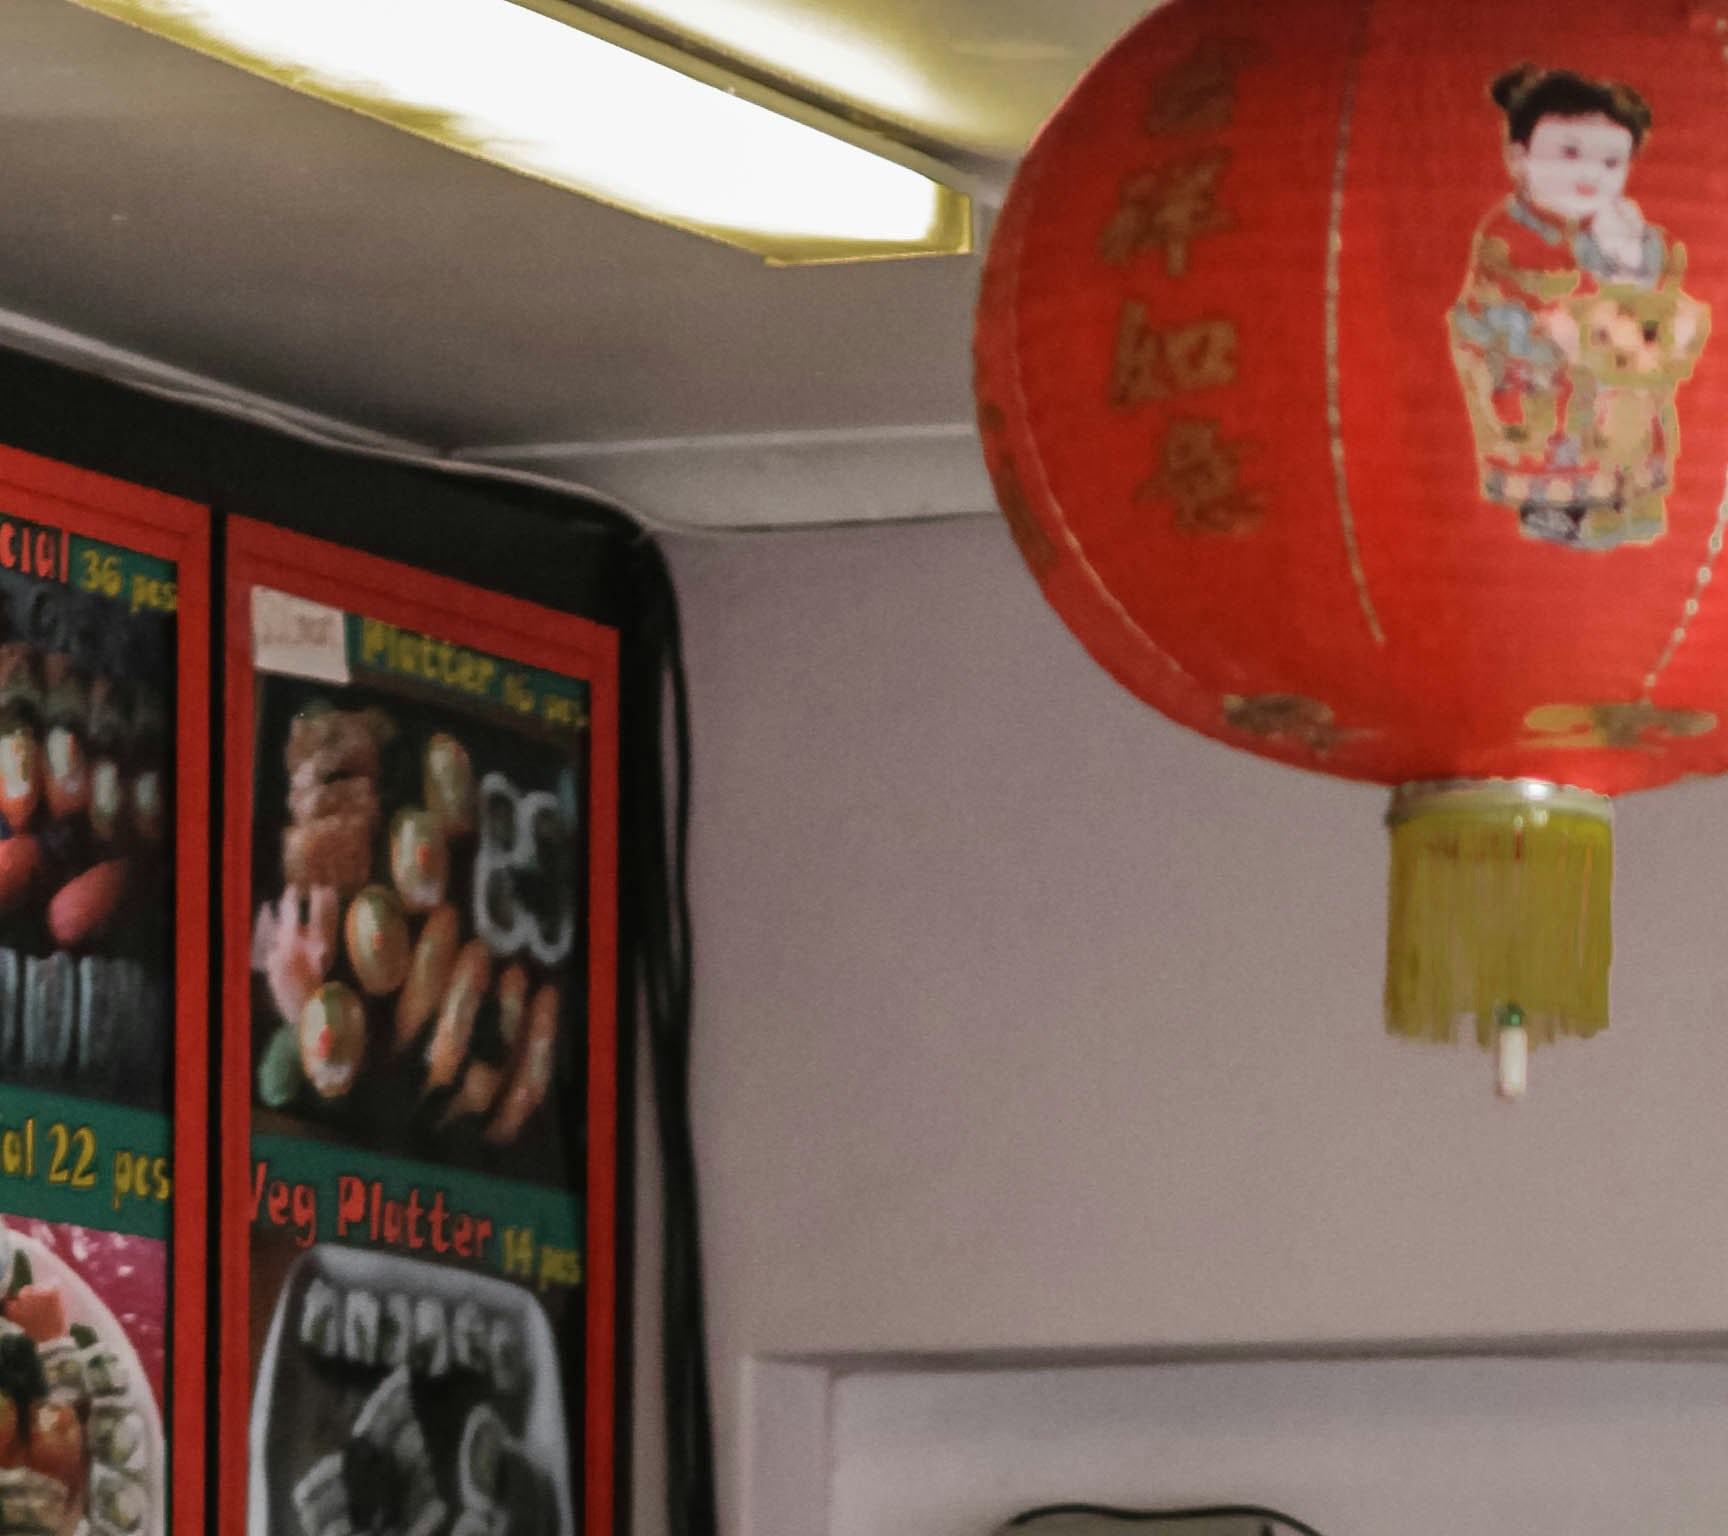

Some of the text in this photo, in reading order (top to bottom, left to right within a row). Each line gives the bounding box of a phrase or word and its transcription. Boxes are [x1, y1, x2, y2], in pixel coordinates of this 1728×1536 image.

[80, 549, 123, 598] 36
[49, 1122, 97, 1188] 22
[112, 1150, 171, 1210] pcs
[338, 1176, 493, 1258] Platter
